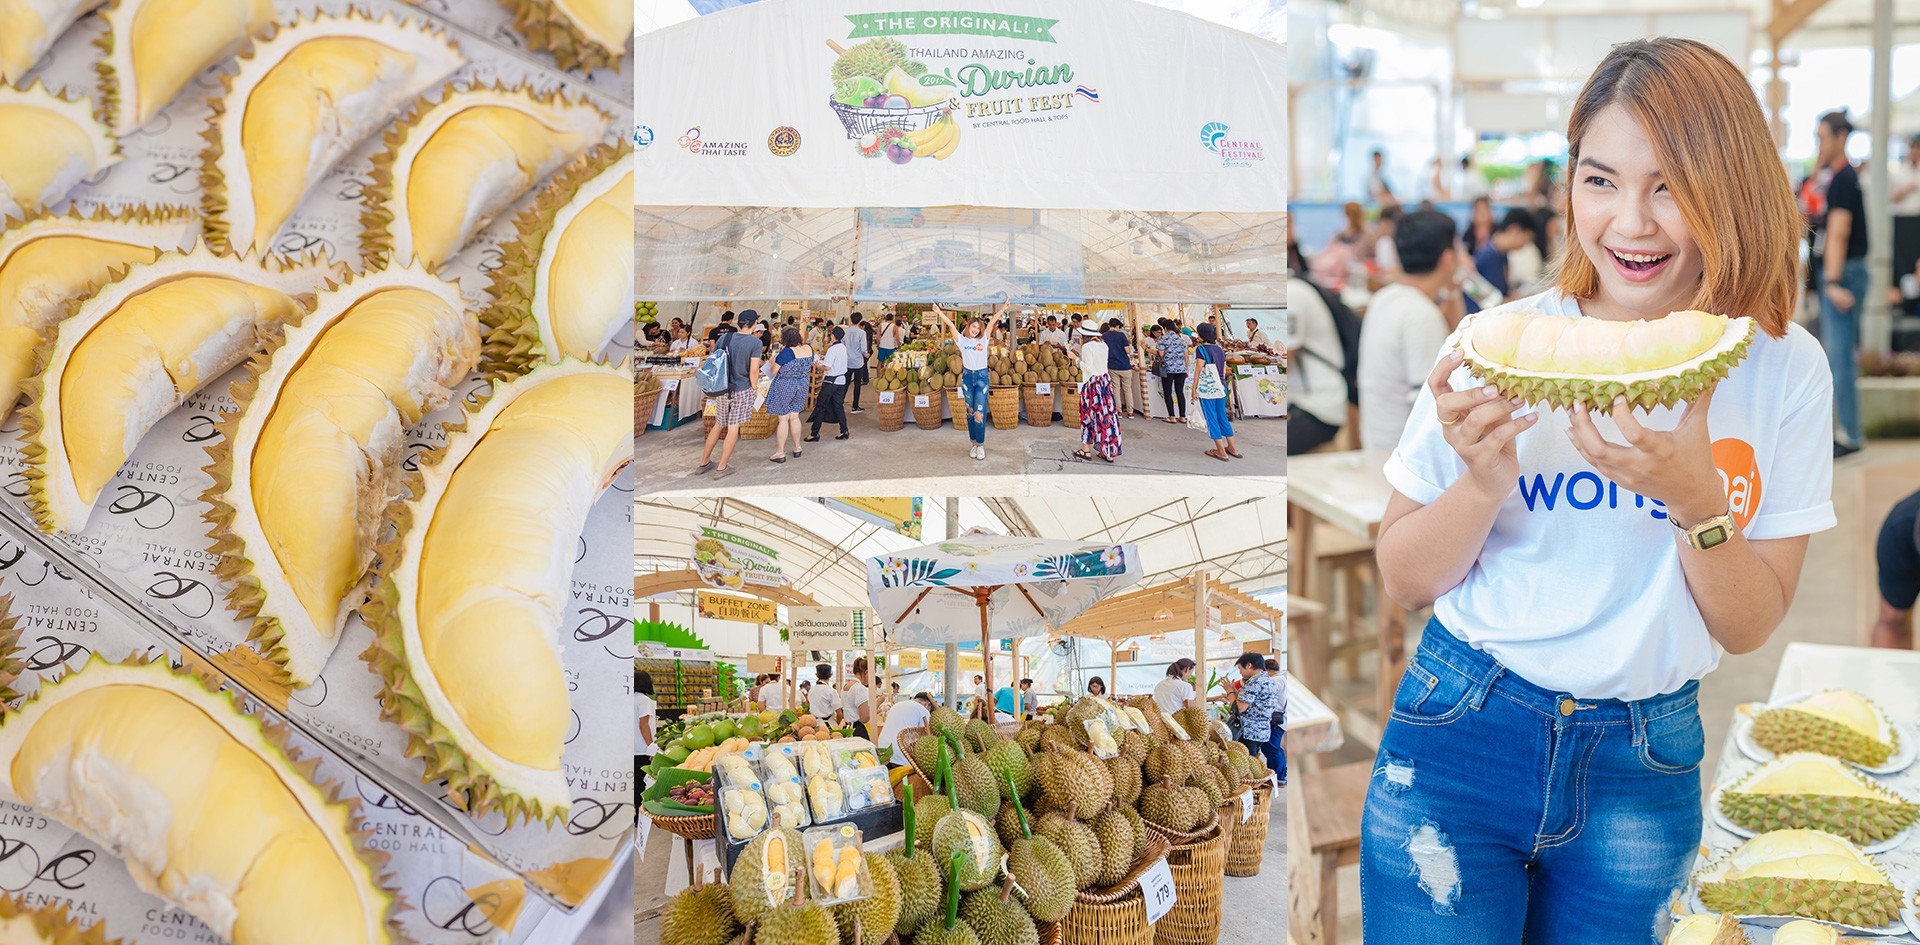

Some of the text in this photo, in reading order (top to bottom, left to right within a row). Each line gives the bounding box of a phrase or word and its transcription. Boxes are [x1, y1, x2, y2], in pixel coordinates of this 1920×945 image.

[874, 16, 1029, 34] THE ORIGINAL!
[909, 47, 1025, 59] THAILAND AMAZING
[922, 77, 945, 86] 2017
[956, 58, 1075, 98] Durian
[949, 93, 1074, 118] & FRUIT FEST
[982, 119, 1009, 128] CENTRAL
[1011, 118, 1029, 126] FOOD
[1030, 116, 1047, 124] HALL
[1220, 139, 1261, 149] CENTRAL
[1221, 149, 1262, 159] FESTIVAL
[123, 459, 182, 474] FOOD HA
[116, 469, 179, 485] CENTRA
[711, 530, 771, 554] THE ORIGINAL!
[145, 542, 221, 562] FOOD HALL
[143, 552, 217, 573] CENTRAL
[742, 558, 783, 576] Durian
[744, 571, 782, 584] FRUIT FEST
[571, 580, 634, 597] OOD HAL
[572, 590, 629, 607] ENTRA
[709, 596, 770, 611] BUFFET ZONE
[29, 604, 99, 618] FOOD HALL
[718, 605, 762, 620] 自助餐区
[26, 616, 98, 633] CENTRAL
[564, 763, 634, 780] OOD HAL
[565, 776, 628, 792] ENTRA
[0, 813, 48, 830] CENT
[361, 821, 446, 840] CENTRAL
[369, 838, 446, 854] OOD HALL
[25, 891, 98, 914] ENTRAL
[1155, 884, 1170, 905] 179
[141, 923, 187, 940] FOOD
